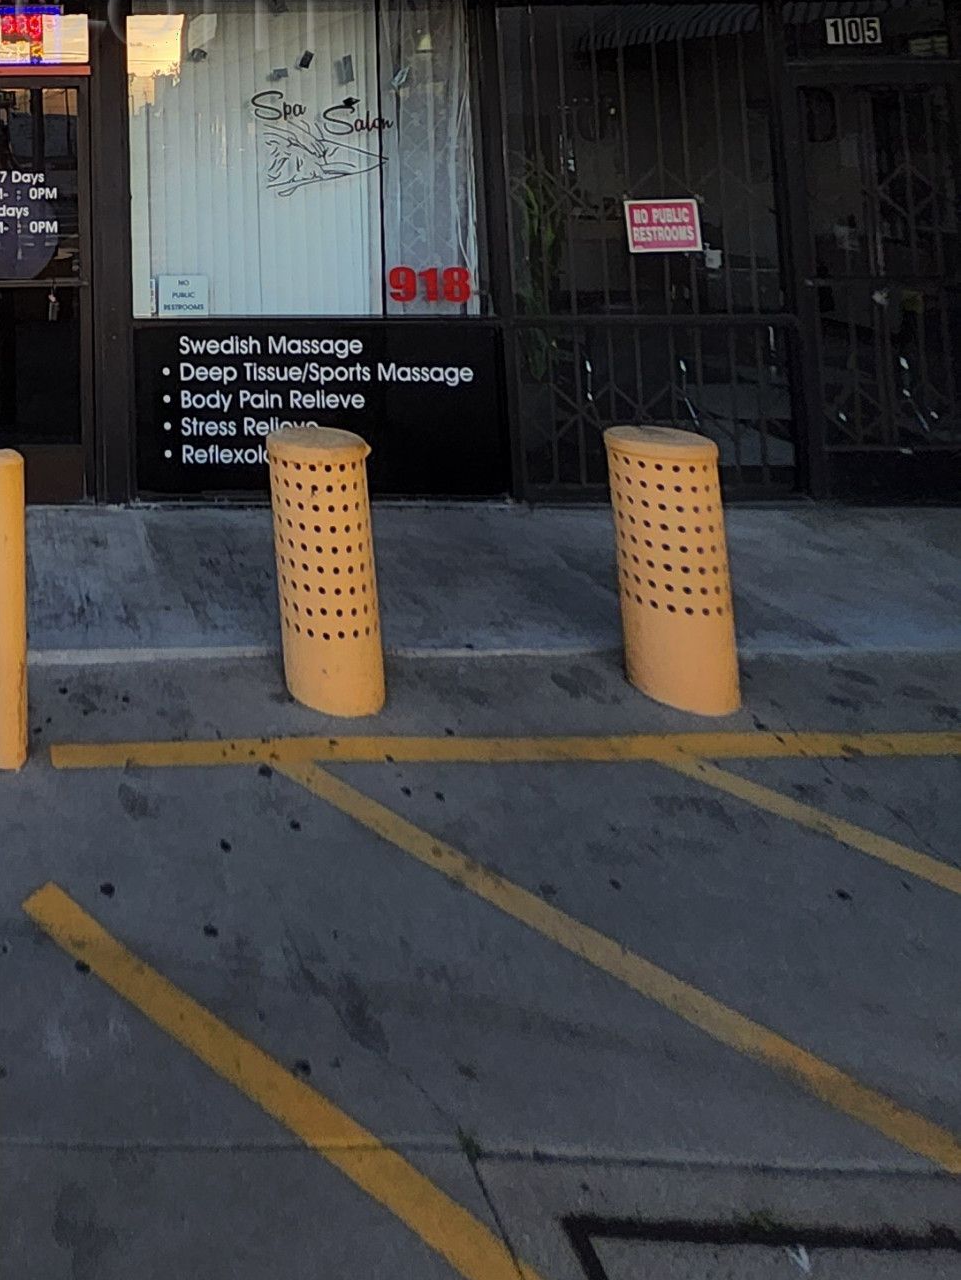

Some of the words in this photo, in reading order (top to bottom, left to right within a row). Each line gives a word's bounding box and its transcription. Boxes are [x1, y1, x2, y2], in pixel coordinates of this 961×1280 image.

[830, 20, 879, 43] 105
[251, 90, 307, 121] Spa
[323, 104, 394, 135] Salon
[0, 171, 8, 183] 7
[12, 171, 45, 186] Days
[633, 208, 648, 224] NO
[651, 207, 690, 224] PUBLIC
[633, 226, 695, 242] RESTROOMS
[389, 266, 471, 303] 918
[179, 336, 261, 355] Swedish
[268, 336, 363, 359] Massage
[179, 363, 237, 385] Deep
[243, 363, 371, 385] Tissue/Sports
[377, 363, 474, 386] Massage
[180, 390, 232, 412] Body
[239, 390, 283, 409] Pain
[289, 390, 365, 409] Relieve
[181, 417, 237, 436] Stress
